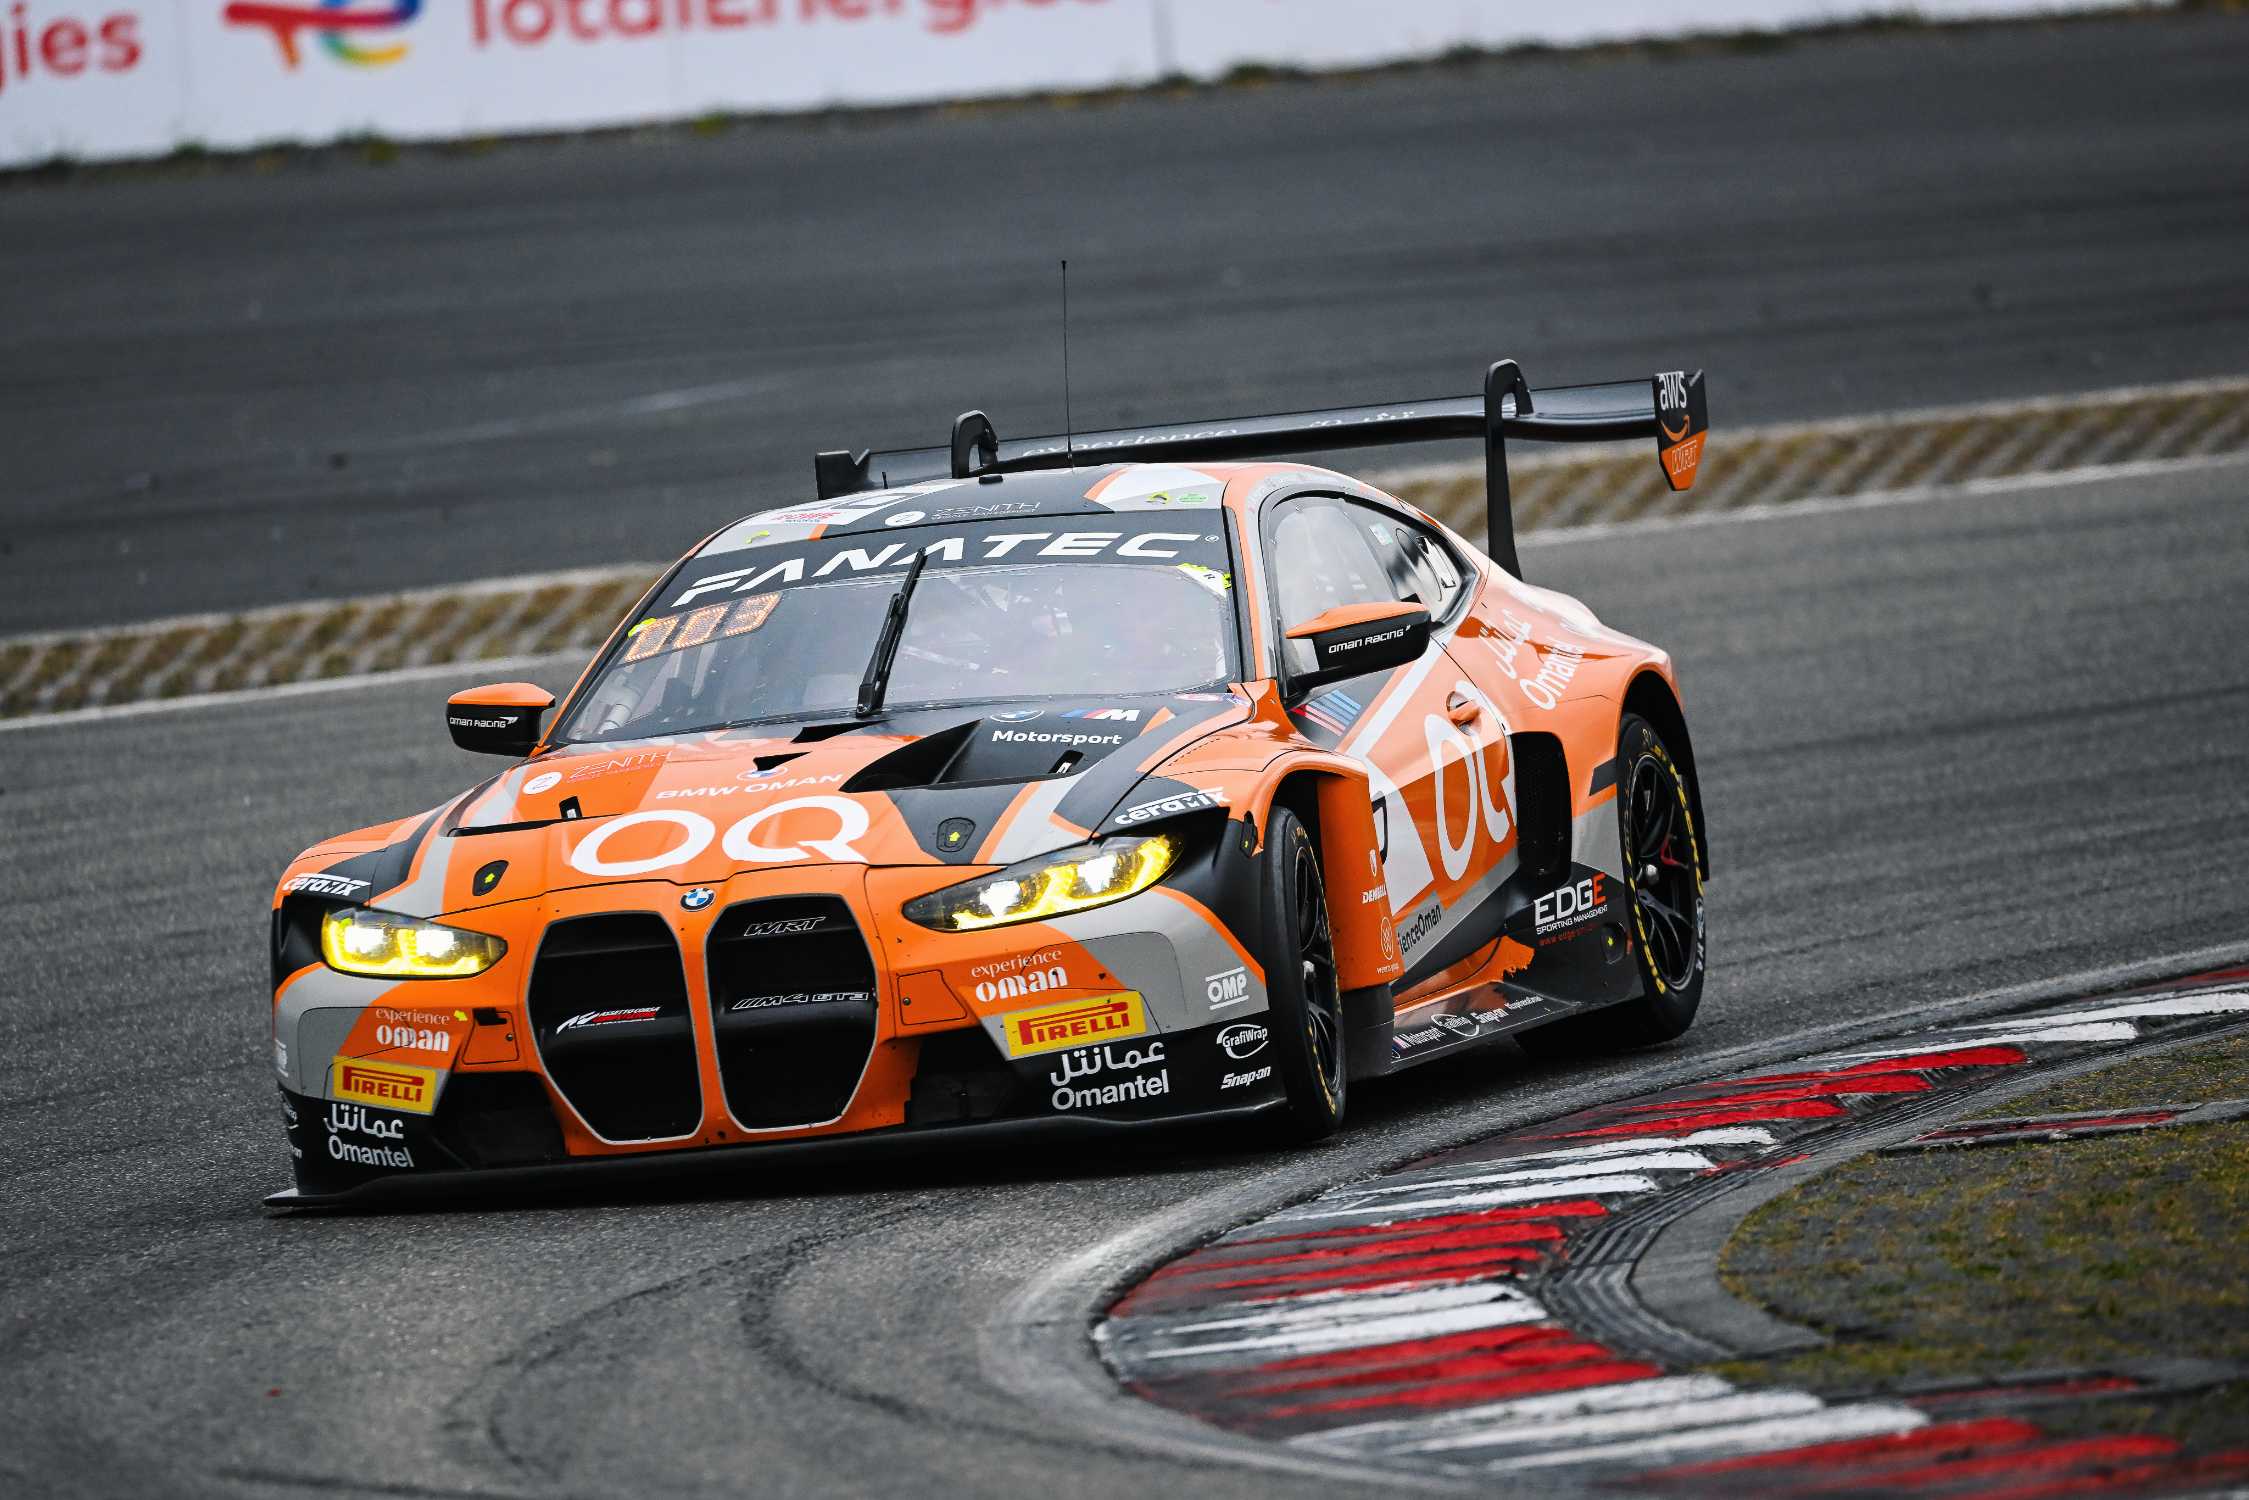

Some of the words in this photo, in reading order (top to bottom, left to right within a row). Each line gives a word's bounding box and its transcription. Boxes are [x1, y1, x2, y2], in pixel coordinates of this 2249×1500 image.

[0, 2, 141, 91] ies
[1656, 370, 1688, 411] aws
[671, 532, 1201, 608] FANATEC
[991, 730, 1123, 746] Motorsport
[655, 785, 740, 800] BMW
[744, 773, 845, 793] OMAN
[571, 795, 869, 877] OQ
[1534, 871, 1607, 926] EDGE
[743, 916, 827, 937] WRT
[1536, 917, 1573, 935] SPORTING
[971, 949, 1063, 979] experience
[975, 966, 1069, 1003] oman
[1207, 973, 1248, 1003] OMP
[375, 1008, 451, 1026] experience
[1017, 1001, 1131, 1046] PIRELLI
[375, 1024, 450, 1053] oman
[1222, 1027, 1268, 1048] GrafiWrap
[1050, 1041, 1166, 1087] عمانتل
[1220, 1066, 1272, 1090] Snap-on
[342, 1065, 425, 1103] PIRELLI
[1051, 1069, 1170, 1110] Omantel
[328, 1134, 415, 1168] Omantel
